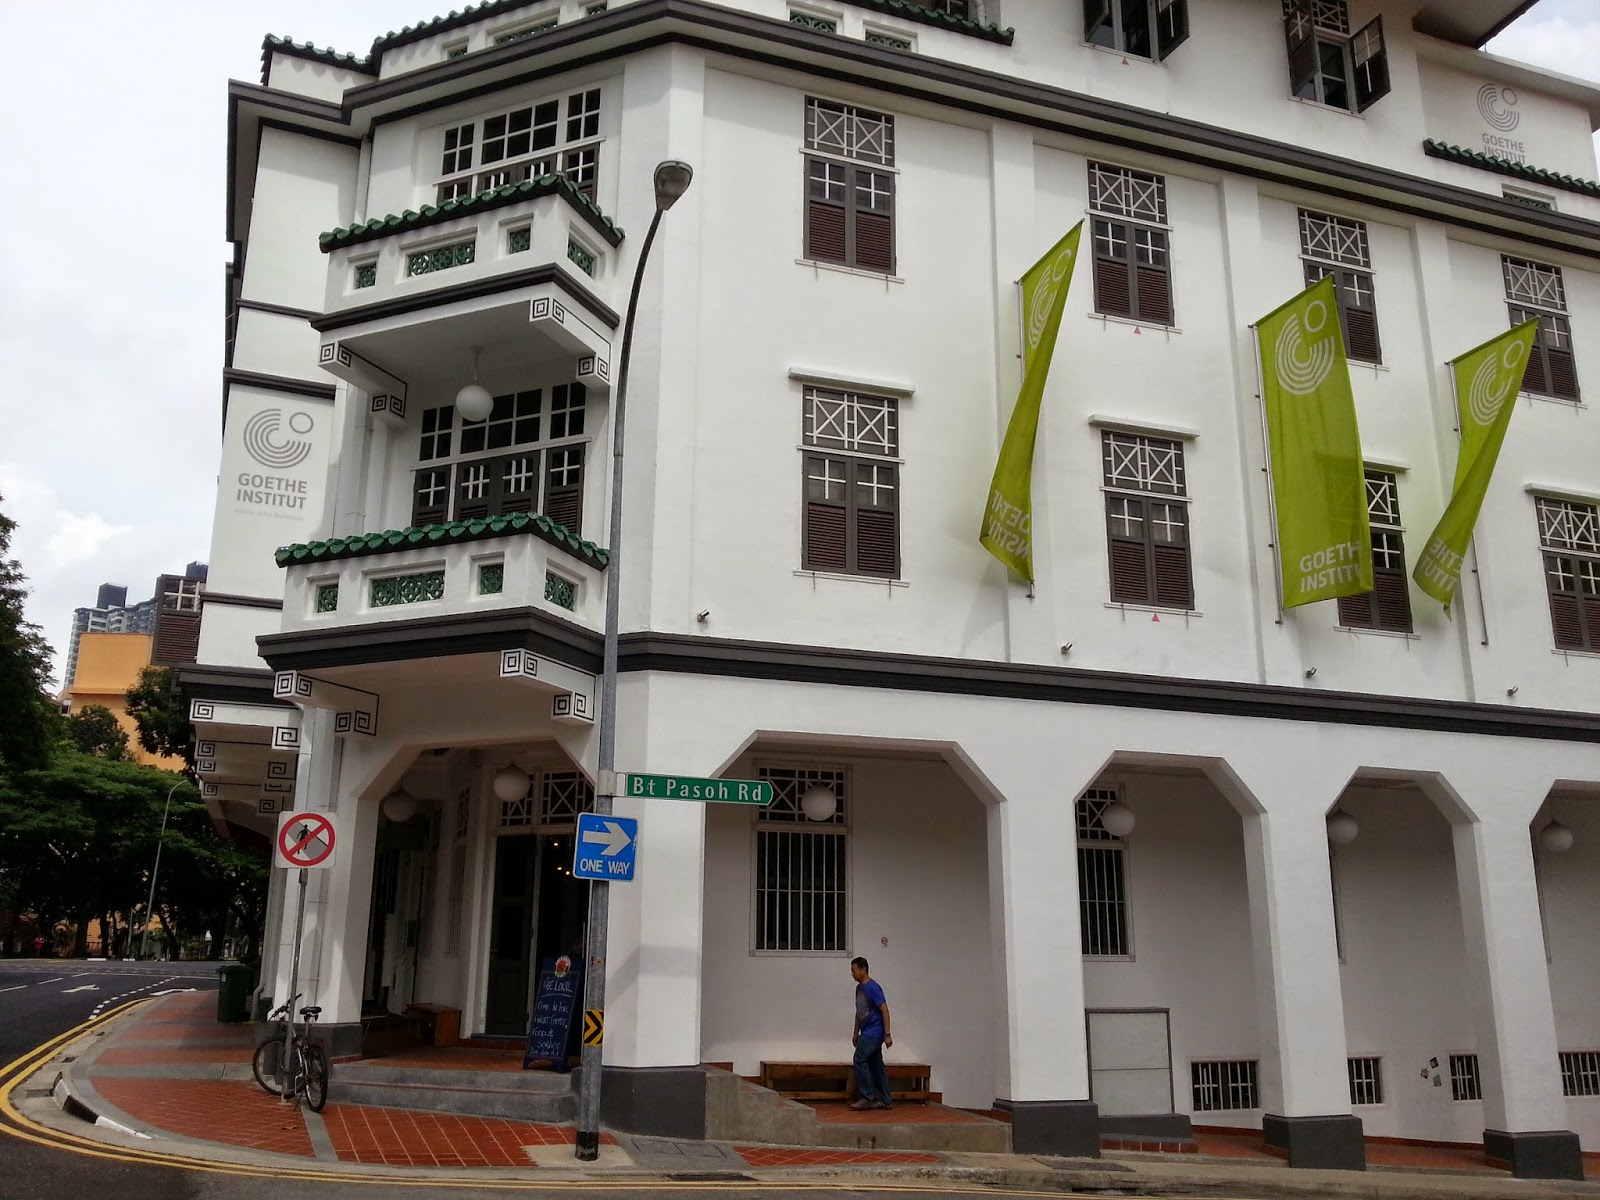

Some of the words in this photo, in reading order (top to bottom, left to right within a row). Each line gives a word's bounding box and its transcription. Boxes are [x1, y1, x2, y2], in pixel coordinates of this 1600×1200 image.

[1482, 133, 1525, 153] GOETHE
[1483, 145, 1526, 165] INSTITUT
[238, 473, 307, 494] GOETHE
[236, 489, 307, 509] INSTITUT
[633, 777, 655, 795] Bt
[666, 778, 729, 799] Pasoh
[738, 783, 762, 801] Rd
[580, 858, 603, 873] ONE
[607, 860, 630, 875] WAY
